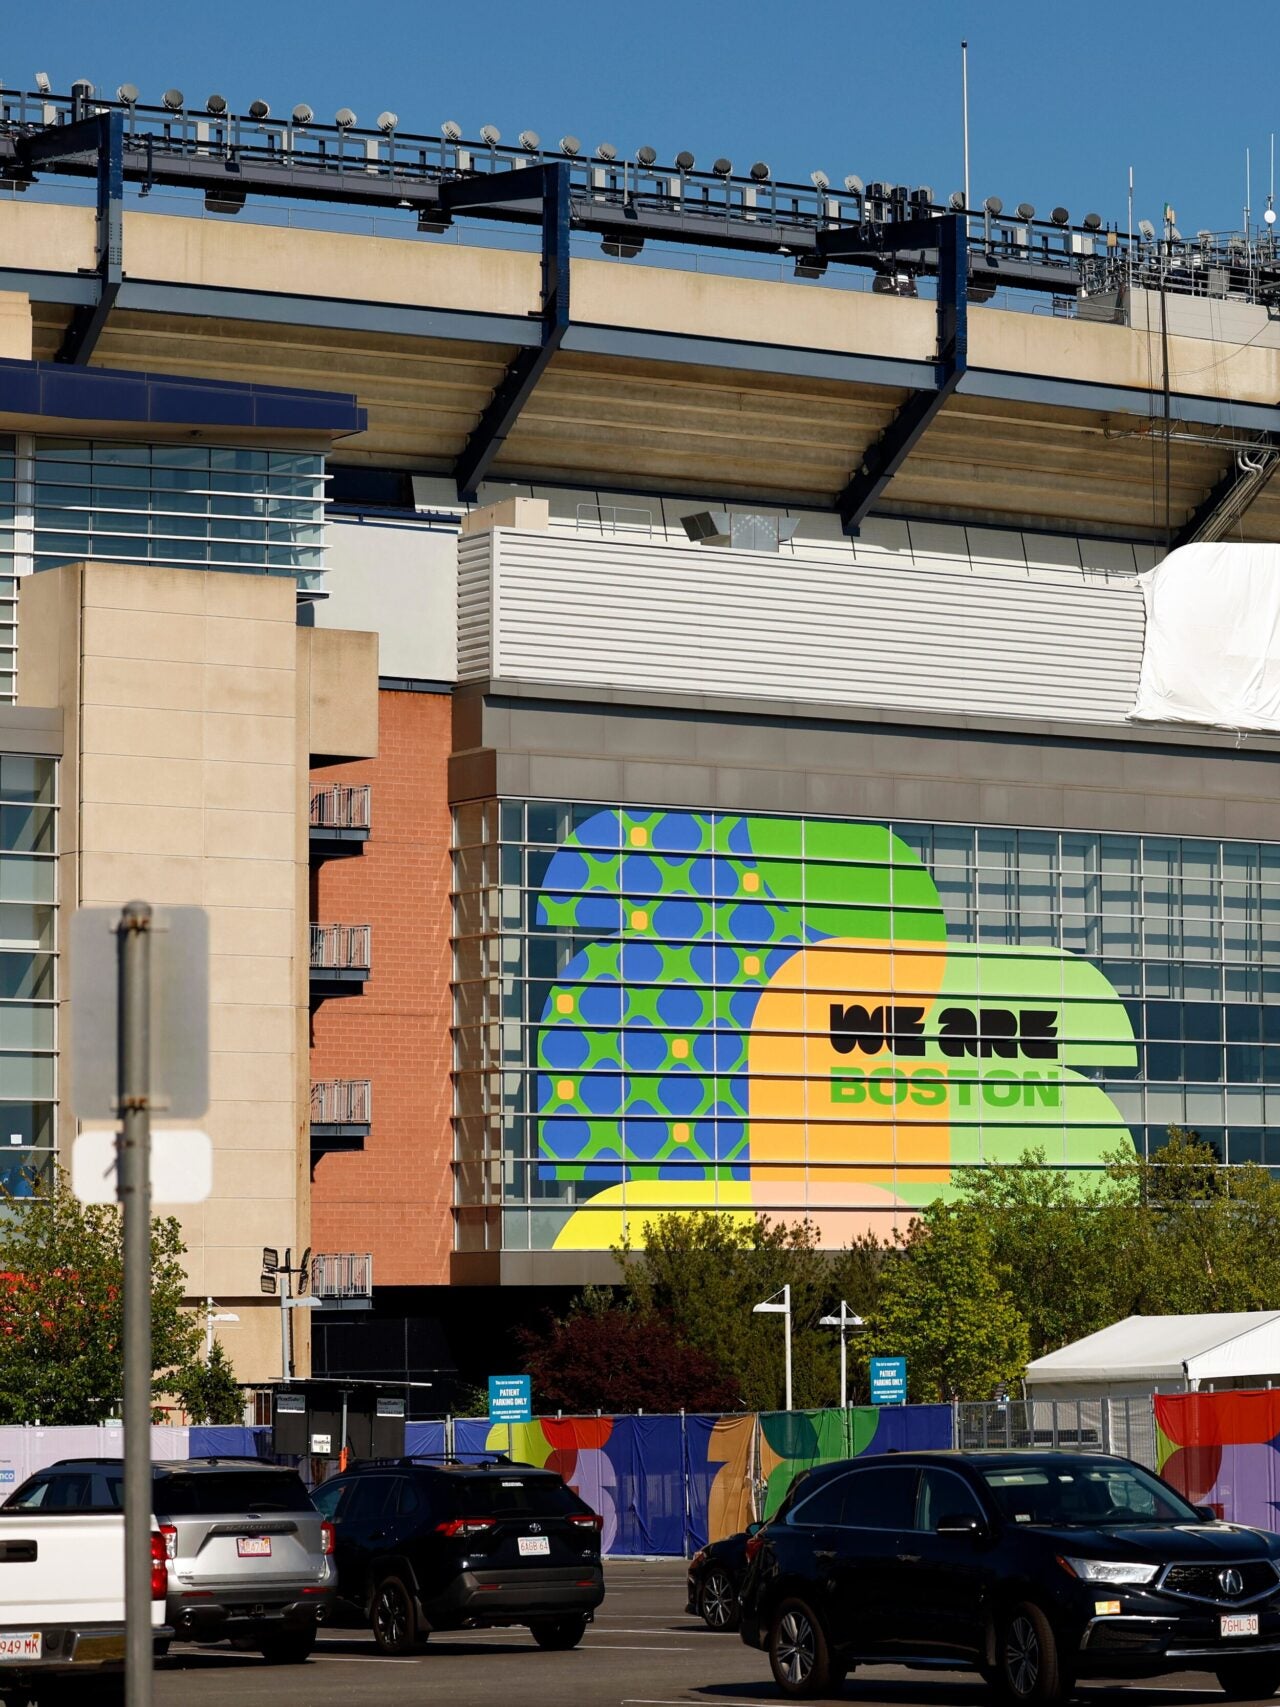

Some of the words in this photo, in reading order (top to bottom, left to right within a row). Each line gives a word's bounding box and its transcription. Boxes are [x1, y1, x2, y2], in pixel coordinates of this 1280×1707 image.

[830, 1003, 926, 1056] WE
[830, 1066, 1059, 1107] BOSTON
[500, 1388, 520, 1396] PATIENT
[493, 1398, 514, 1406] PARKING
[1222, 1619, 1244, 1632] 7GHL
[1247, 1618, 1257, 1630] 30
[24, 1639, 39, 1654] MK
